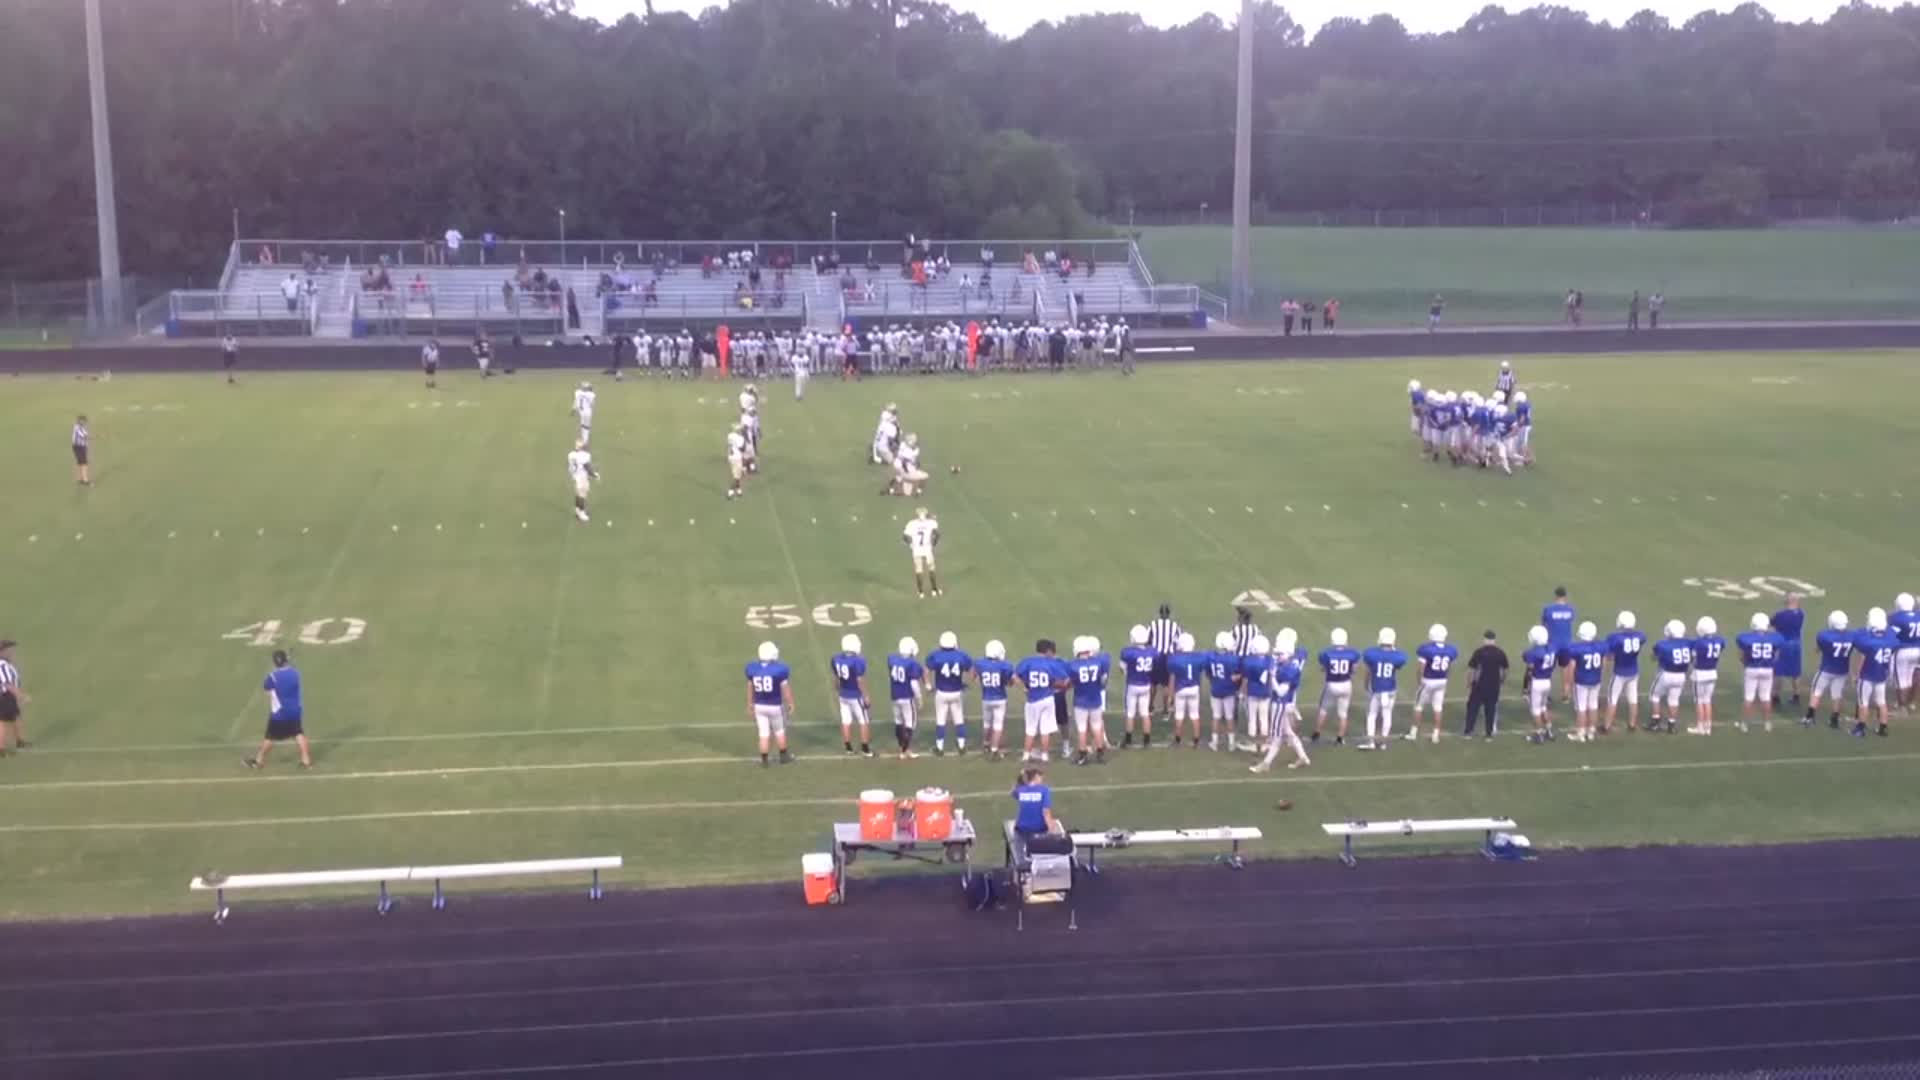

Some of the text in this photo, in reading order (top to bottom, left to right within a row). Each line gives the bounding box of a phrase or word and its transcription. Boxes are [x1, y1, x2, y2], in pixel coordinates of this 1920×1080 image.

[1682, 575, 1826, 600] 30
[1231, 587, 1356, 613] 40
[744, 602, 873, 629] 50
[221, 617, 367, 646] 40
[1671, 647, 1691, 665] 99
[1751, 642, 1773, 659] 52
[1832, 642, 1853, 658] 77
[1874, 647, 1892, 664] 42
[1135, 656, 1153, 673] 32
[1329, 659, 1350, 675] 30
[1431, 655, 1450, 672] 26
[1583, 652, 1602, 670] 70
[890, 665, 906, 683] 40
[940, 662, 961, 679] 44
[1078, 665, 1099, 683] 67
[1187, 663, 1193, 680] 1
[1210, 662, 1225, 679] 12
[752, 675, 773, 693] 58
[981, 671, 1001, 688] 28
[1028, 671, 1049, 688] 50
